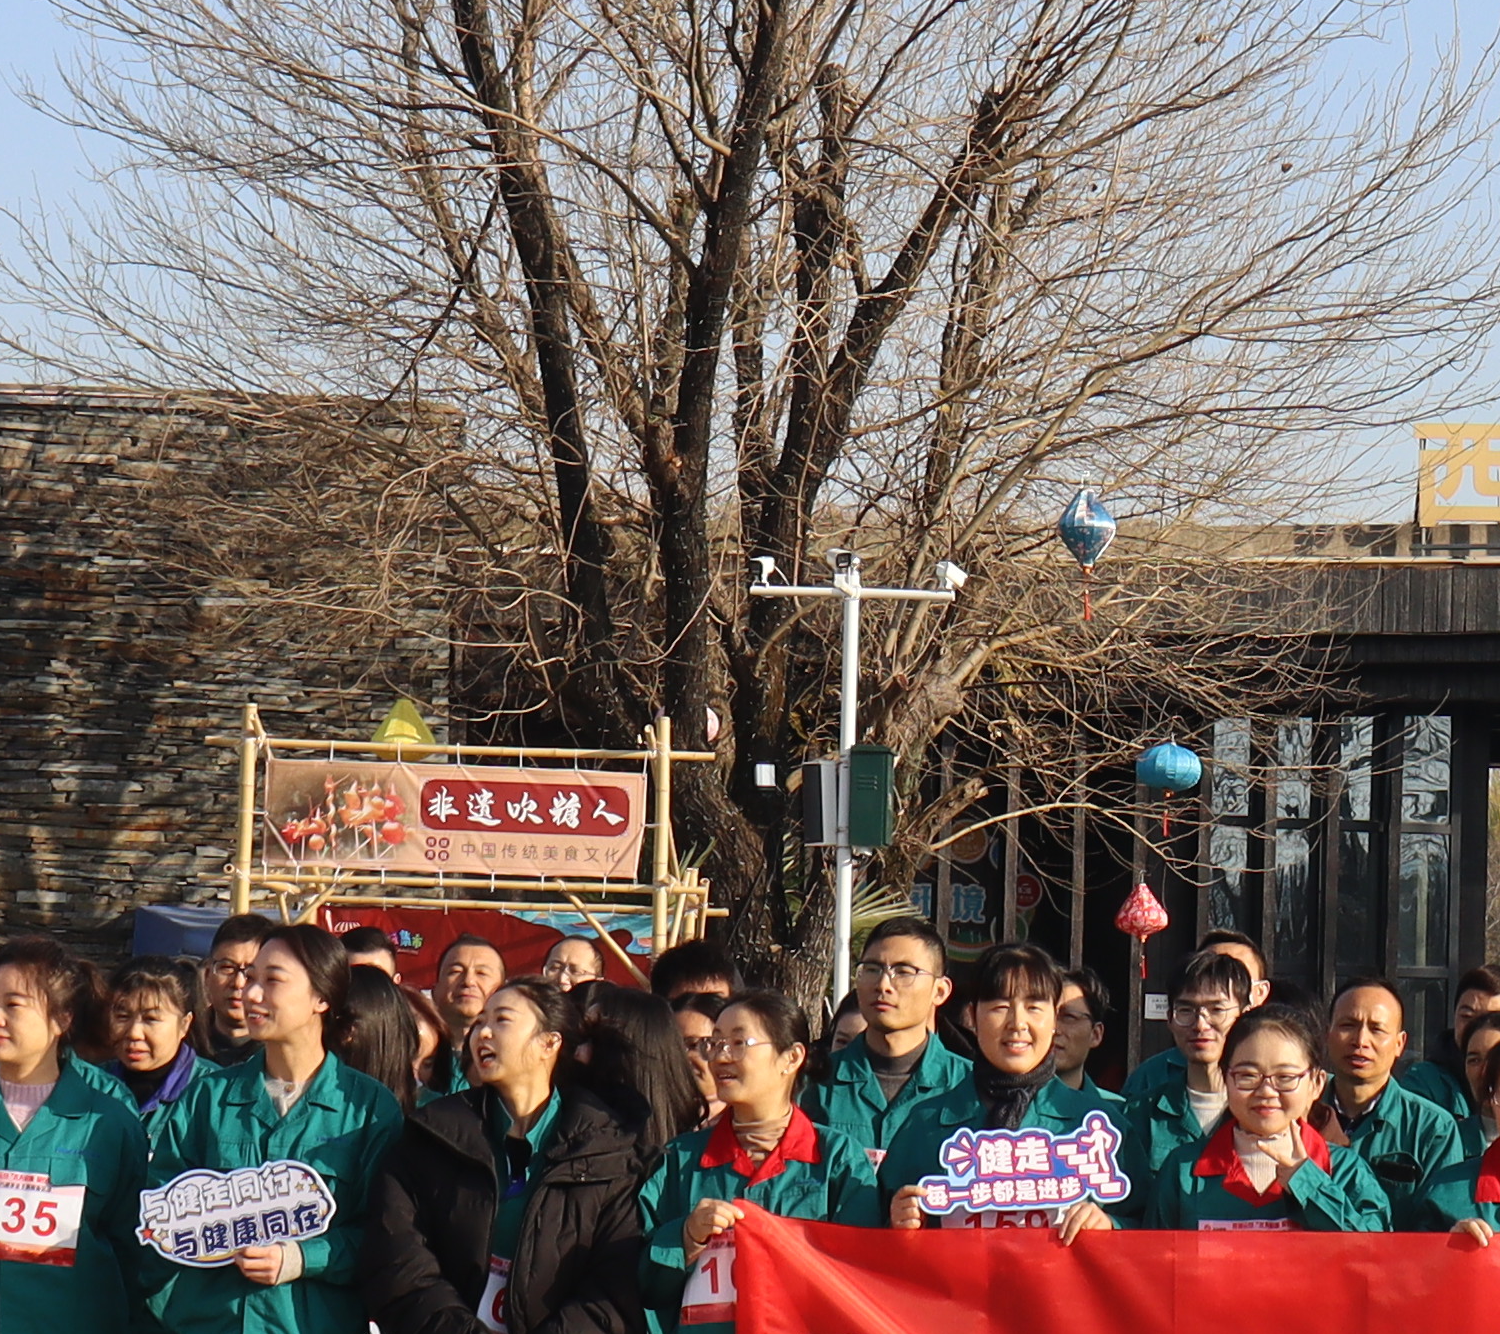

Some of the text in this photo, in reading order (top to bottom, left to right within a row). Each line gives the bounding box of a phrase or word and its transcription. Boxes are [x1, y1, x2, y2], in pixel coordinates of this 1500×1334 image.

[426, 785, 626, 829] 非遗吹糖人
[460, 840, 621, 863] 中国传统美食文化
[977, 1136, 1050, 1175] 健走
[142, 1162, 292, 1223] 与健走同行
[925, 1177, 1082, 1208] 每一步都是进步
[172, 1201, 322, 1258] 与健康同在
